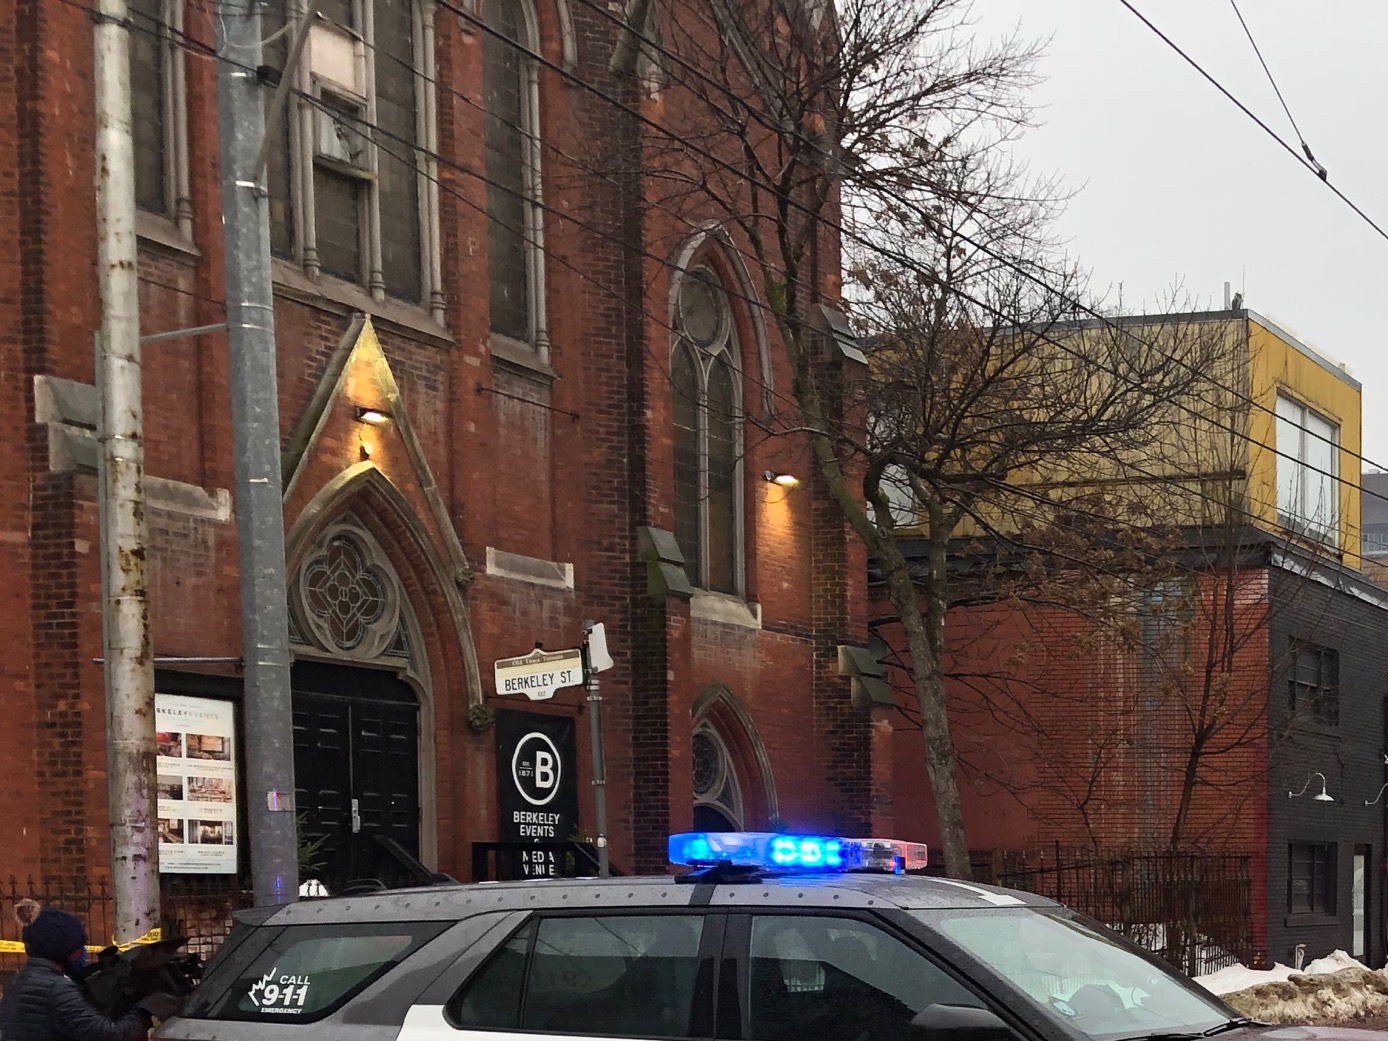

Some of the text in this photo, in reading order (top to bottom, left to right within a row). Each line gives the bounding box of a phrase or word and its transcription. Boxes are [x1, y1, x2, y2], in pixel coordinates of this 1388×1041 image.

[504, 672, 555, 692] BERKELEY
[518, 769, 534, 778] 1871
[535, 750, 555, 788] B
[513, 811, 560, 825] BERKELEY
[519, 824, 555, 838] EVENTS
[522, 850, 555, 863] MEDA
[280, 975, 311, 985] CALL
[261, 984, 308, 1006] 9-1-1
